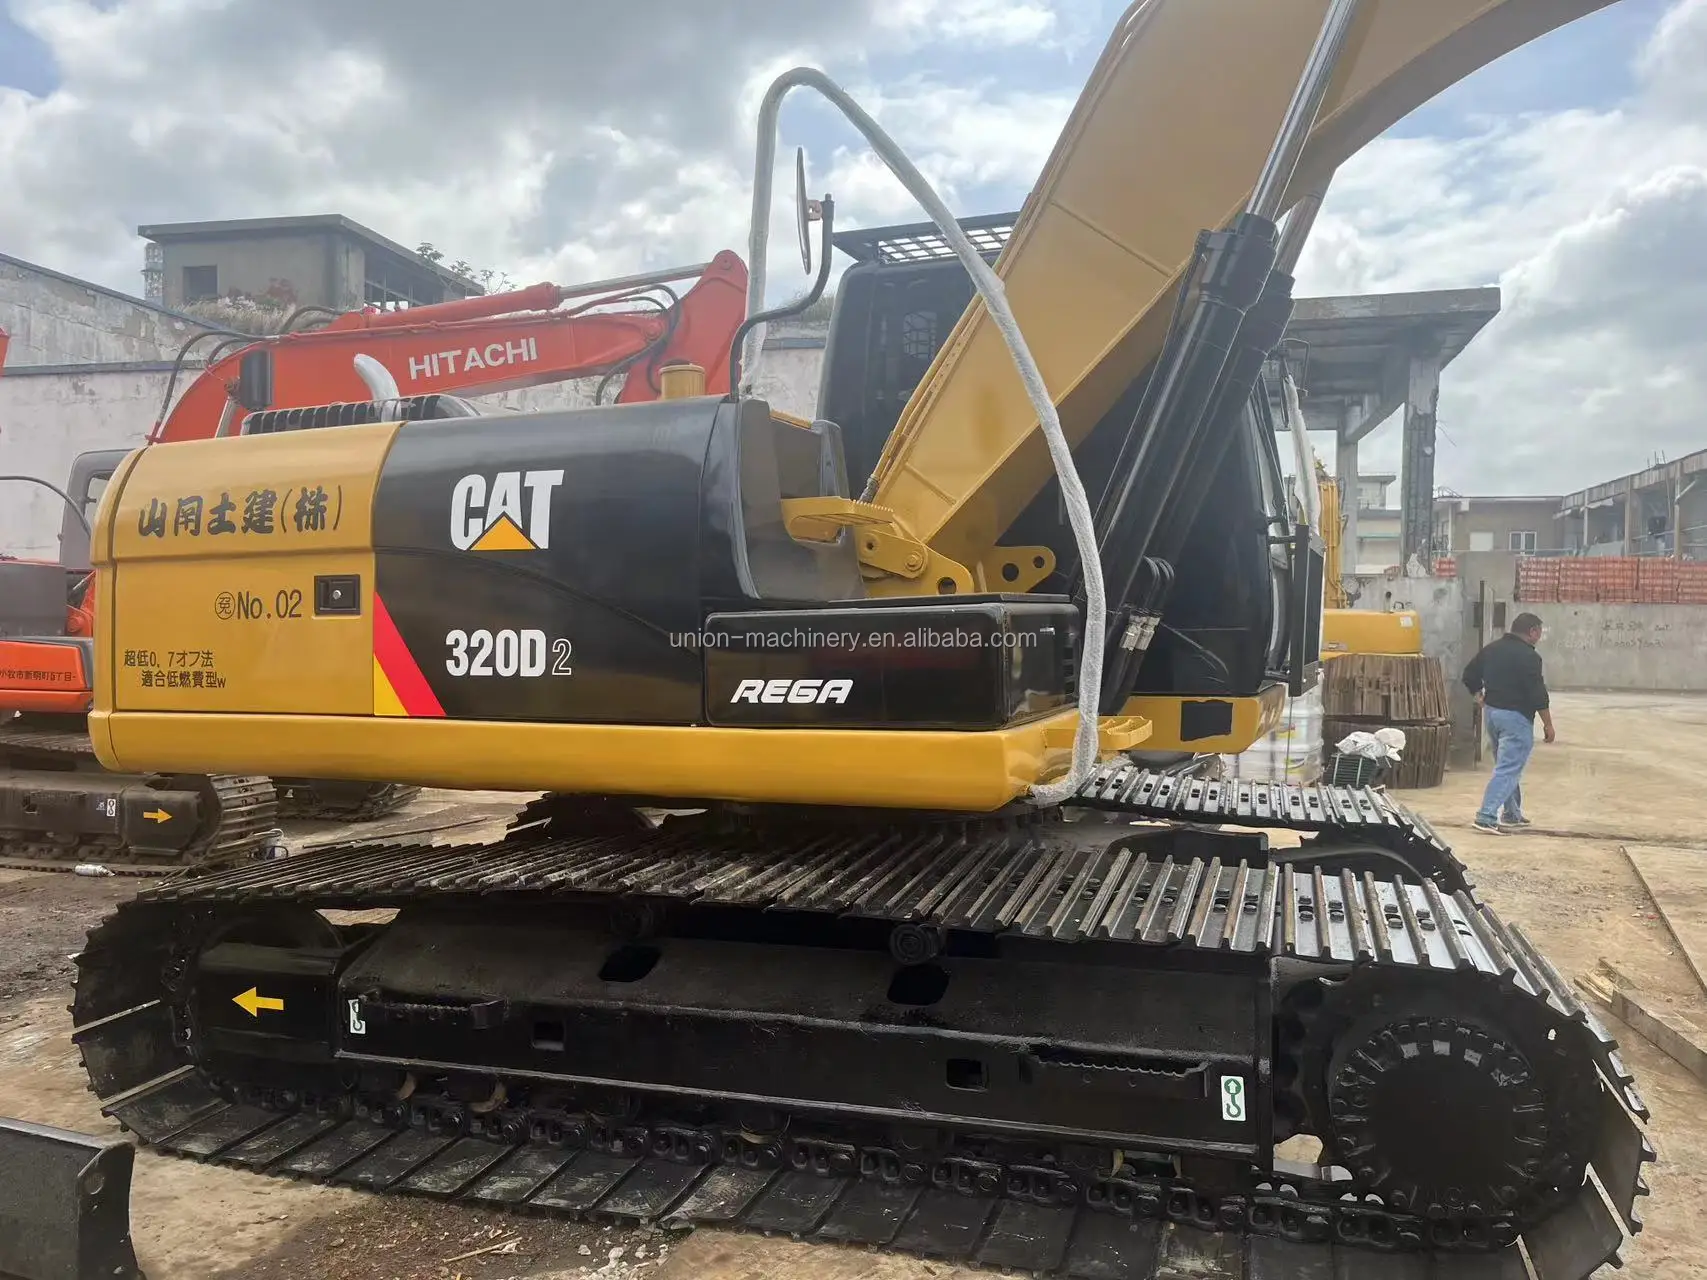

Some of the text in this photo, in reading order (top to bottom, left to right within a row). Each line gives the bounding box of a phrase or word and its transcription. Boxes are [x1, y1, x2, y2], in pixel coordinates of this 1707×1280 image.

[409, 337, 538, 380] HITACHI
[450, 470, 565, 551] CAT
[730, 679, 854, 704] REGA
